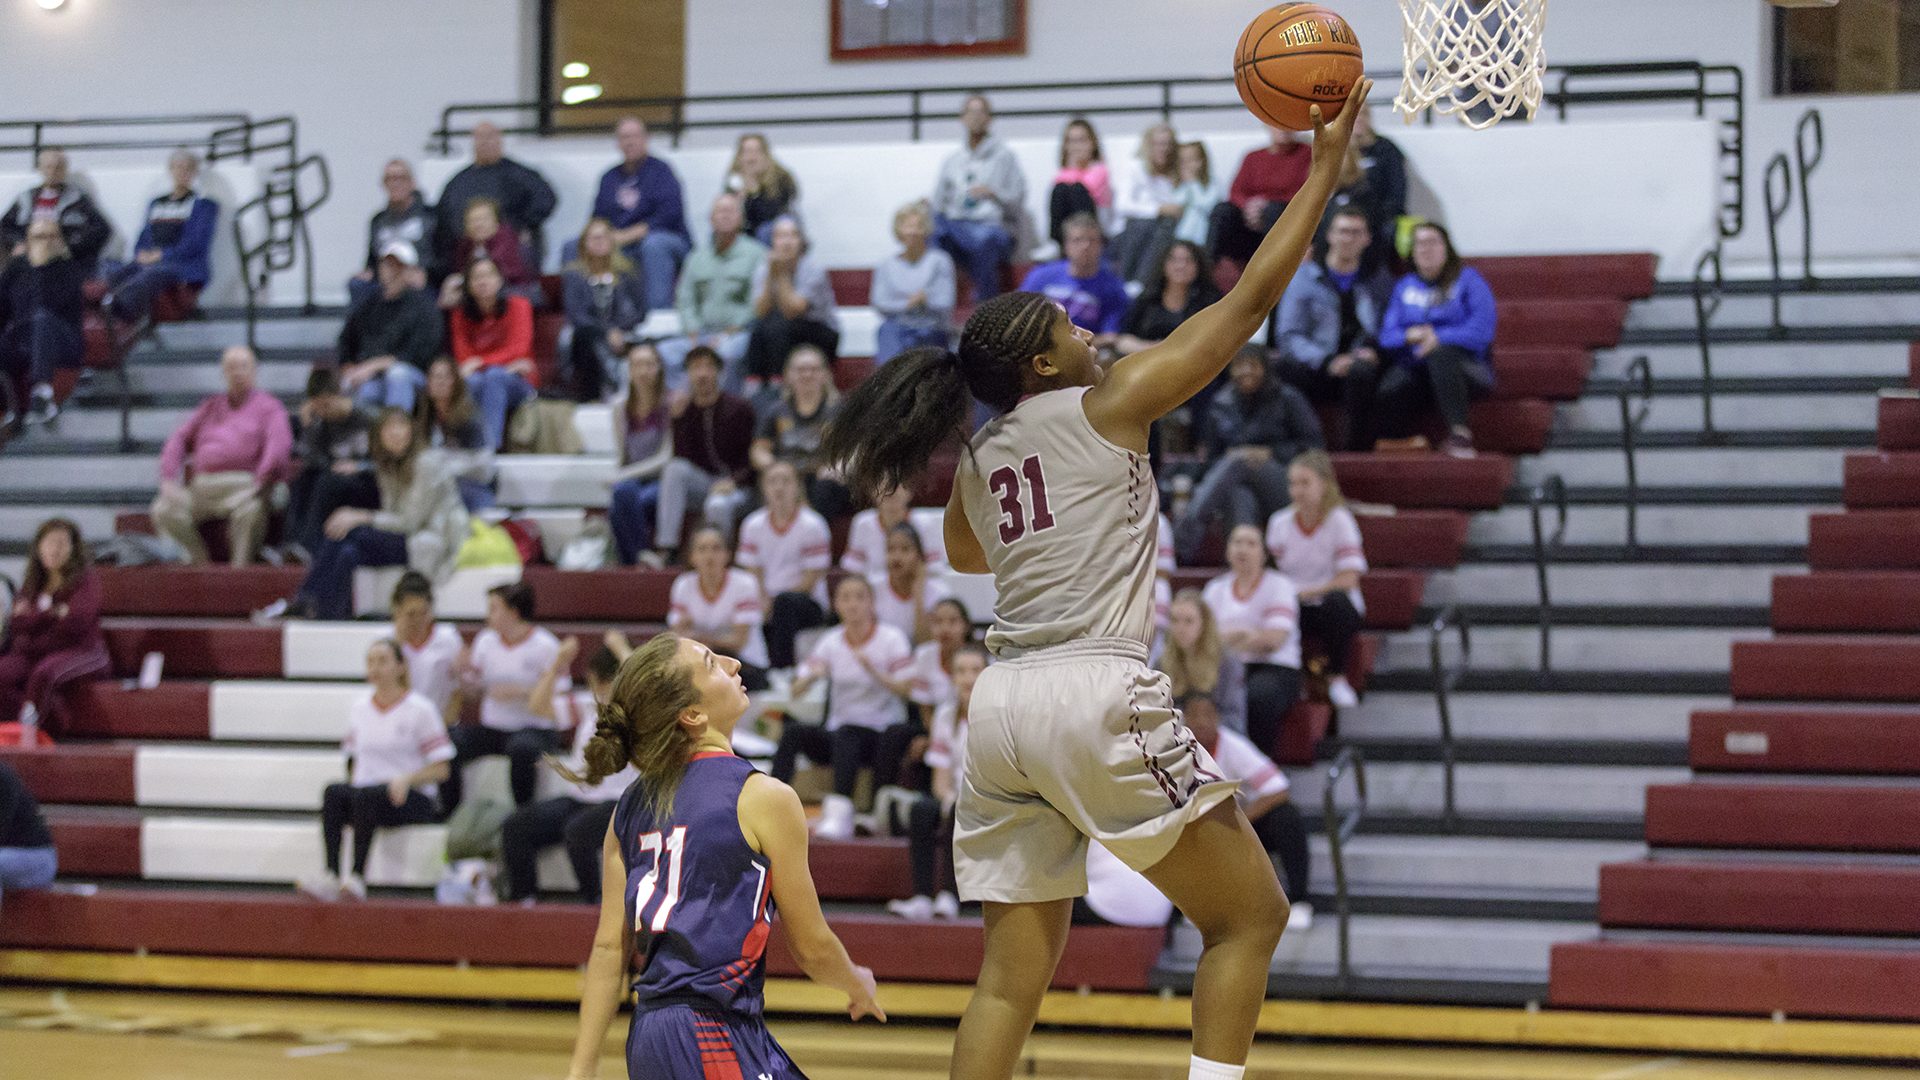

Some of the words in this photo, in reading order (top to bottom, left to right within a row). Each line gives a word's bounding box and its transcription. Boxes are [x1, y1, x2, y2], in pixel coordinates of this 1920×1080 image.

[1279, 19, 1323, 47] THE
[1313, 84, 1345, 96] ROCK
[987, 452, 1057, 548] 31
